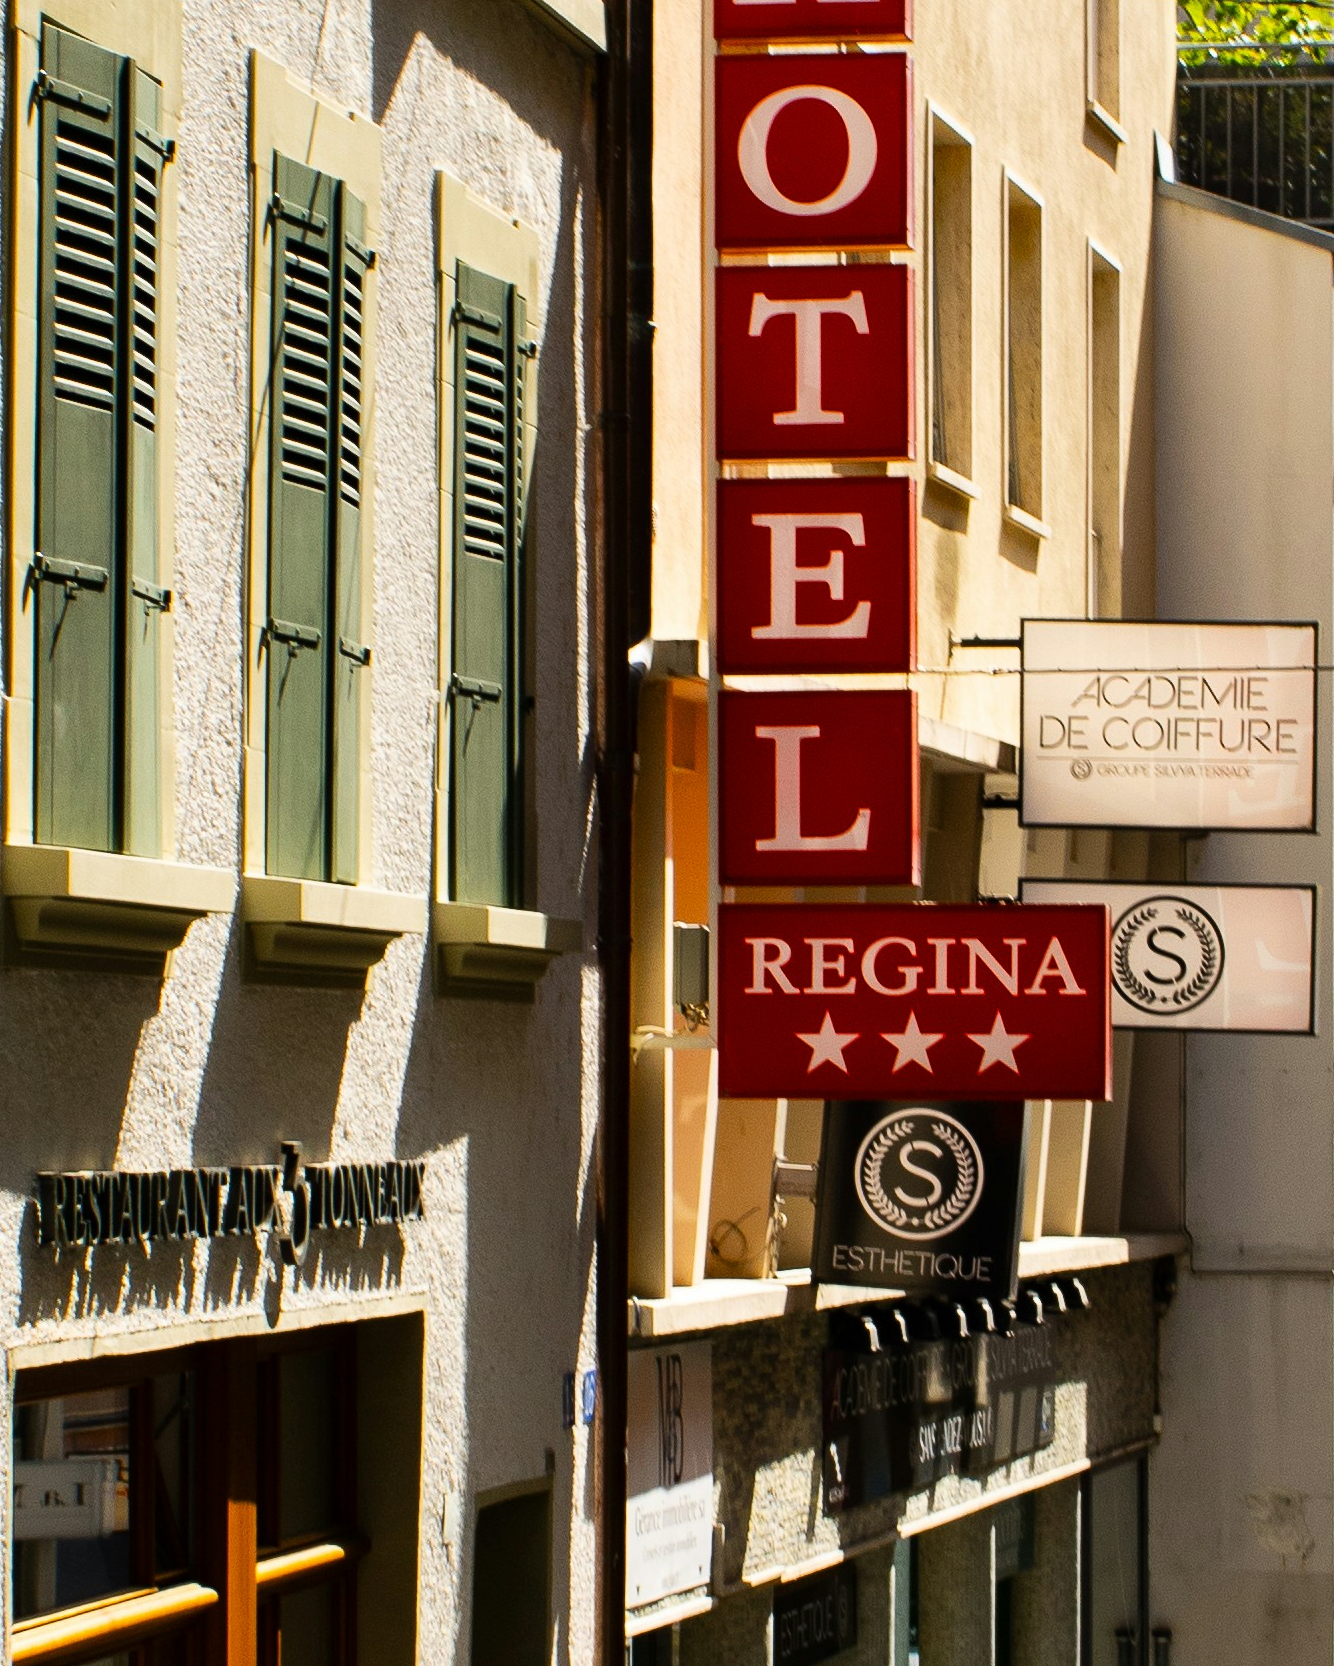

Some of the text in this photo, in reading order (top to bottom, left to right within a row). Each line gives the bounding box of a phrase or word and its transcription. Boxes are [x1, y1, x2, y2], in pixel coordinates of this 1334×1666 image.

[1070, 674, 1269, 712] ACADEMIE
[1038, 714, 1298, 755] DE COIFFURE
[1097, 763, 1151, 779] GROUPE
[744, 935, 1088, 998] REGINA
[39, 1169, 228, 1247] RESTAURANT
[832, 1243, 994, 1284] ESTHETIQUE
